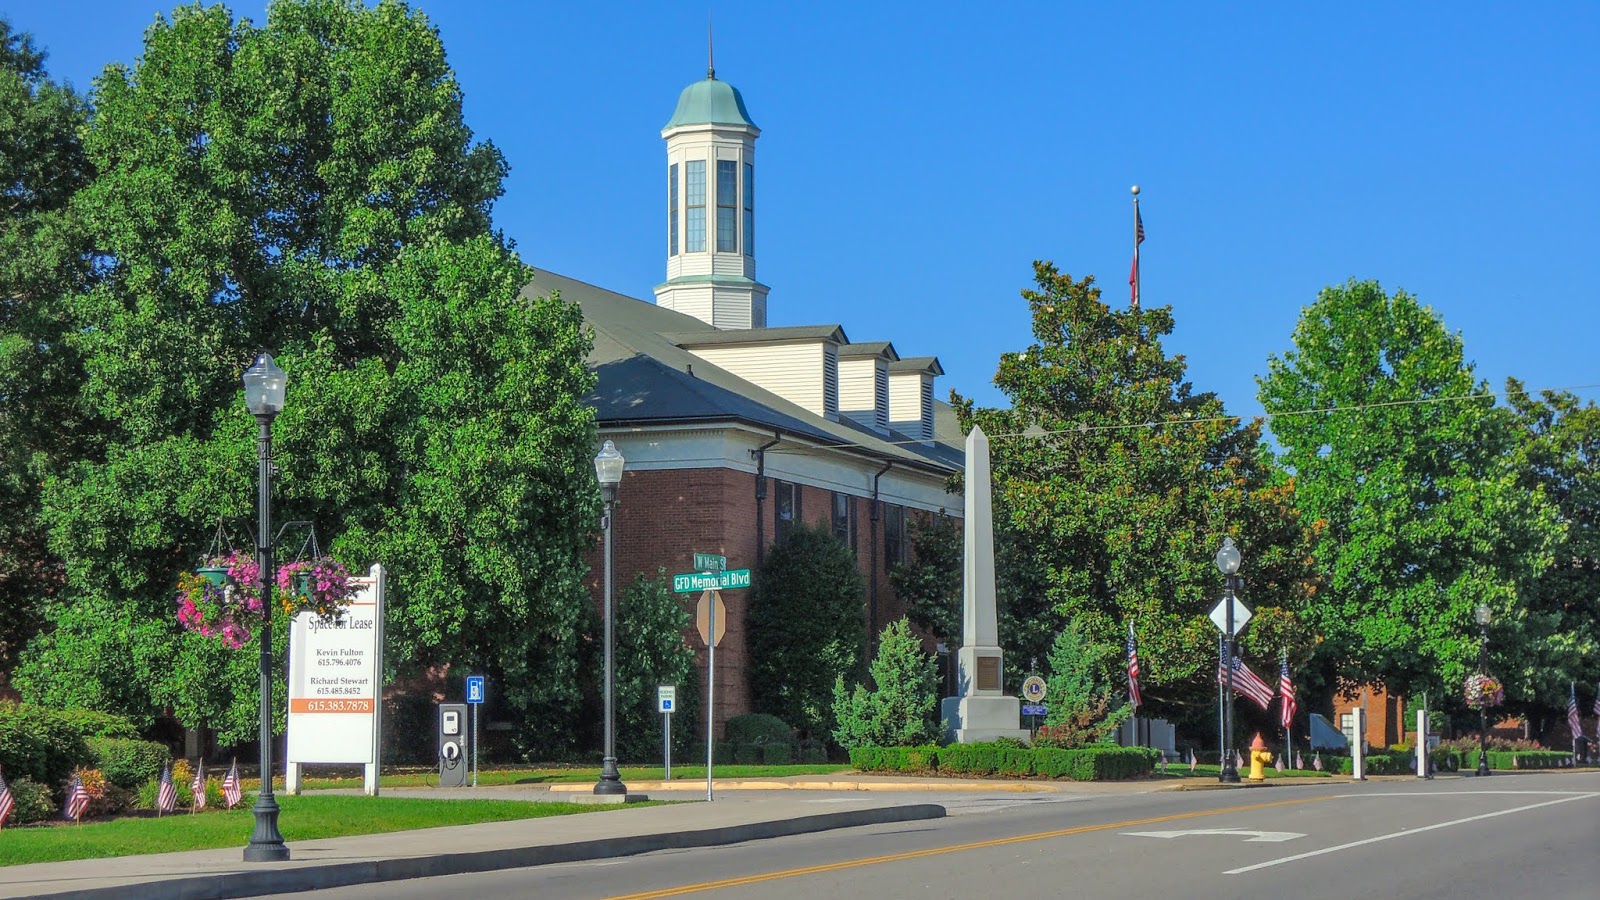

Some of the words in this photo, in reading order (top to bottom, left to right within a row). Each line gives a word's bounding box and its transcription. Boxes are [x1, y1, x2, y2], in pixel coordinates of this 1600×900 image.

[697, 556, 703, 568] W
[704, 557, 719, 570] Main
[675, 577, 690, 590] GFD
[692, 575, 729, 588] Memorial
[731, 572, 749, 585] Blvd
[349, 616, 373, 629] Lease
[316, 648, 338, 656] Kevin
[340, 648, 364, 656] Fulton
[310, 677, 339, 685] Richard
[340, 677, 368, 685] Stewart
[317, 687, 361, 695] 615.485.8452
[308, 700, 369, 711] 615.383.7878
